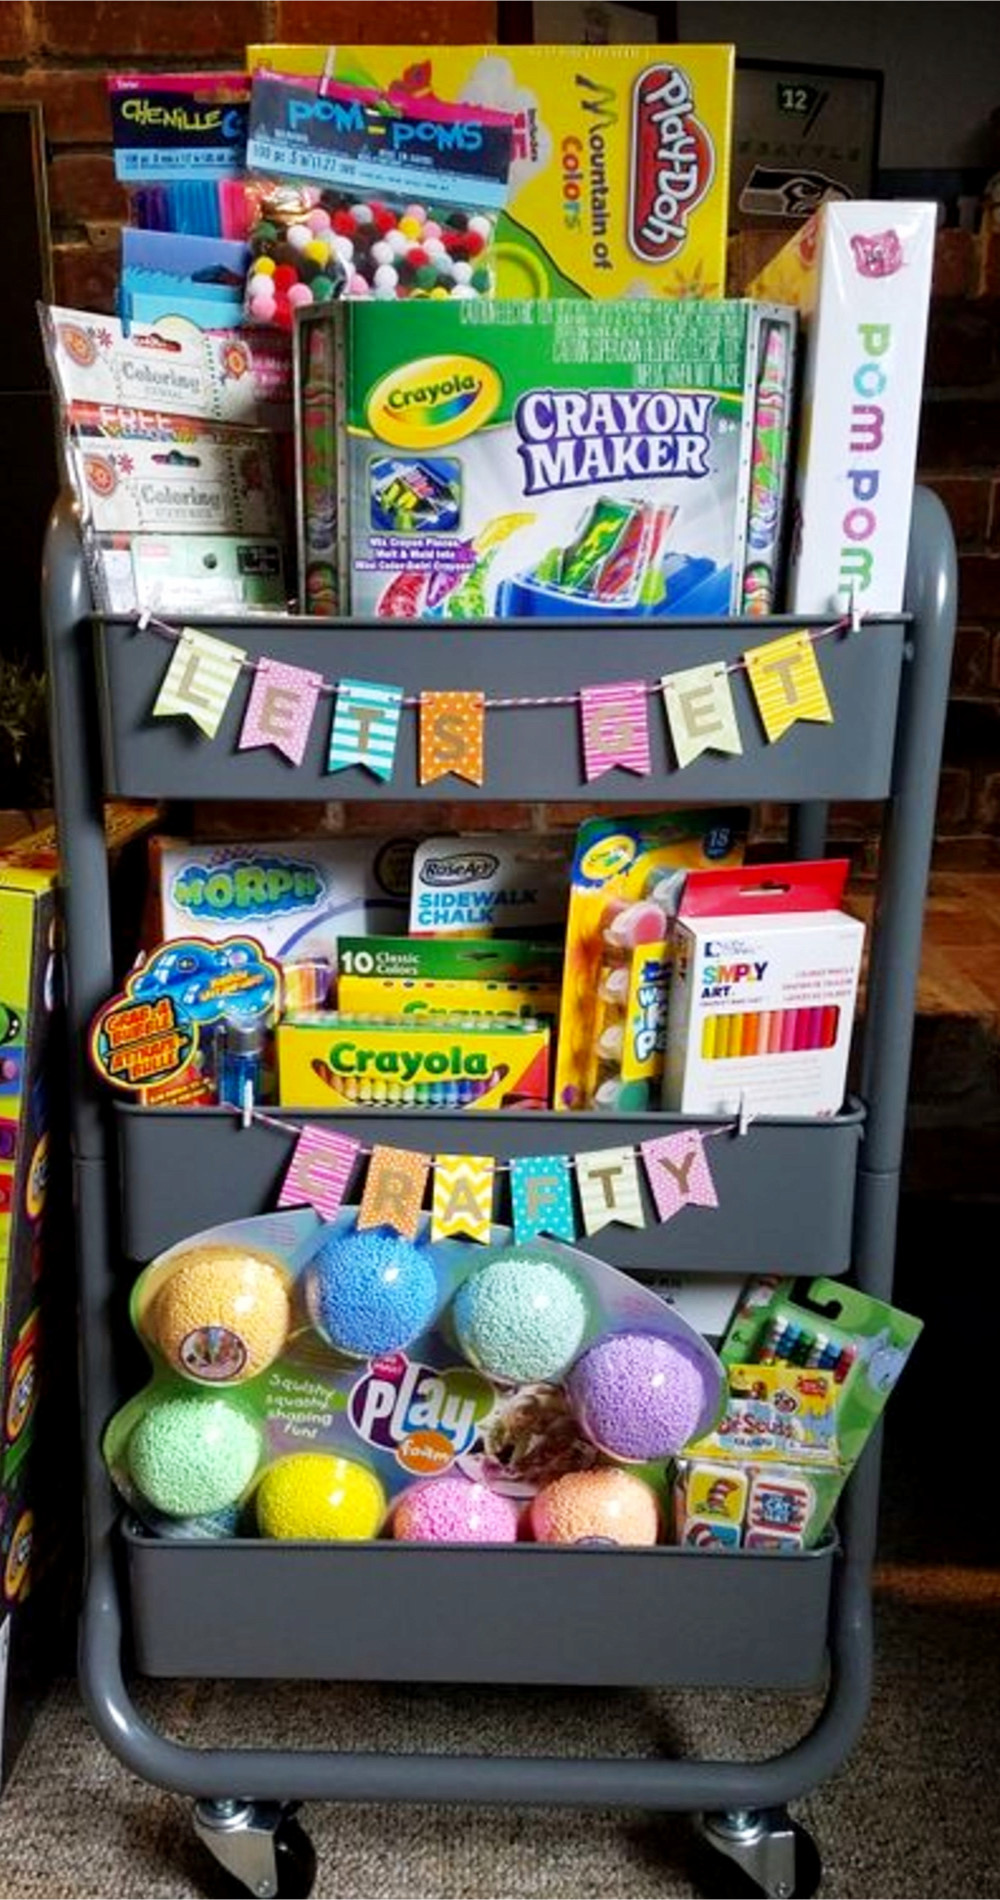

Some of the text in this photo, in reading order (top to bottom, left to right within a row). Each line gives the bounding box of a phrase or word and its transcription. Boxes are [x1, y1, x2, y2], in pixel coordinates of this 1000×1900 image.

[782, 88, 808, 110] 12
[121, 98, 222, 131] CHENILLE
[561, 135, 584, 230] Colors
[575, 73, 617, 270] Mountain of
[122, 361, 201, 393] Coloring
[387, 374, 476, 411] Crayola
[99, 406, 172, 432] FREE
[522, 391, 714, 444] CRAYON
[526, 435, 708, 490] MAKER
[141, 483, 222, 510] Coloring
[426, 857, 494, 880] RoseArt
[174, 866, 317, 908] MORPH
[418, 889, 538, 909] SIDEWALK
[418, 907, 494, 926] CHALK
[341, 951, 374, 974] 10
[376, 952, 420, 964] Classic
[376, 964, 419, 976] Colors
[329, 1042, 488, 1081] Crayola
[268, 1409, 332, 1426] shaping
[401, 1440, 452, 1463] foam
